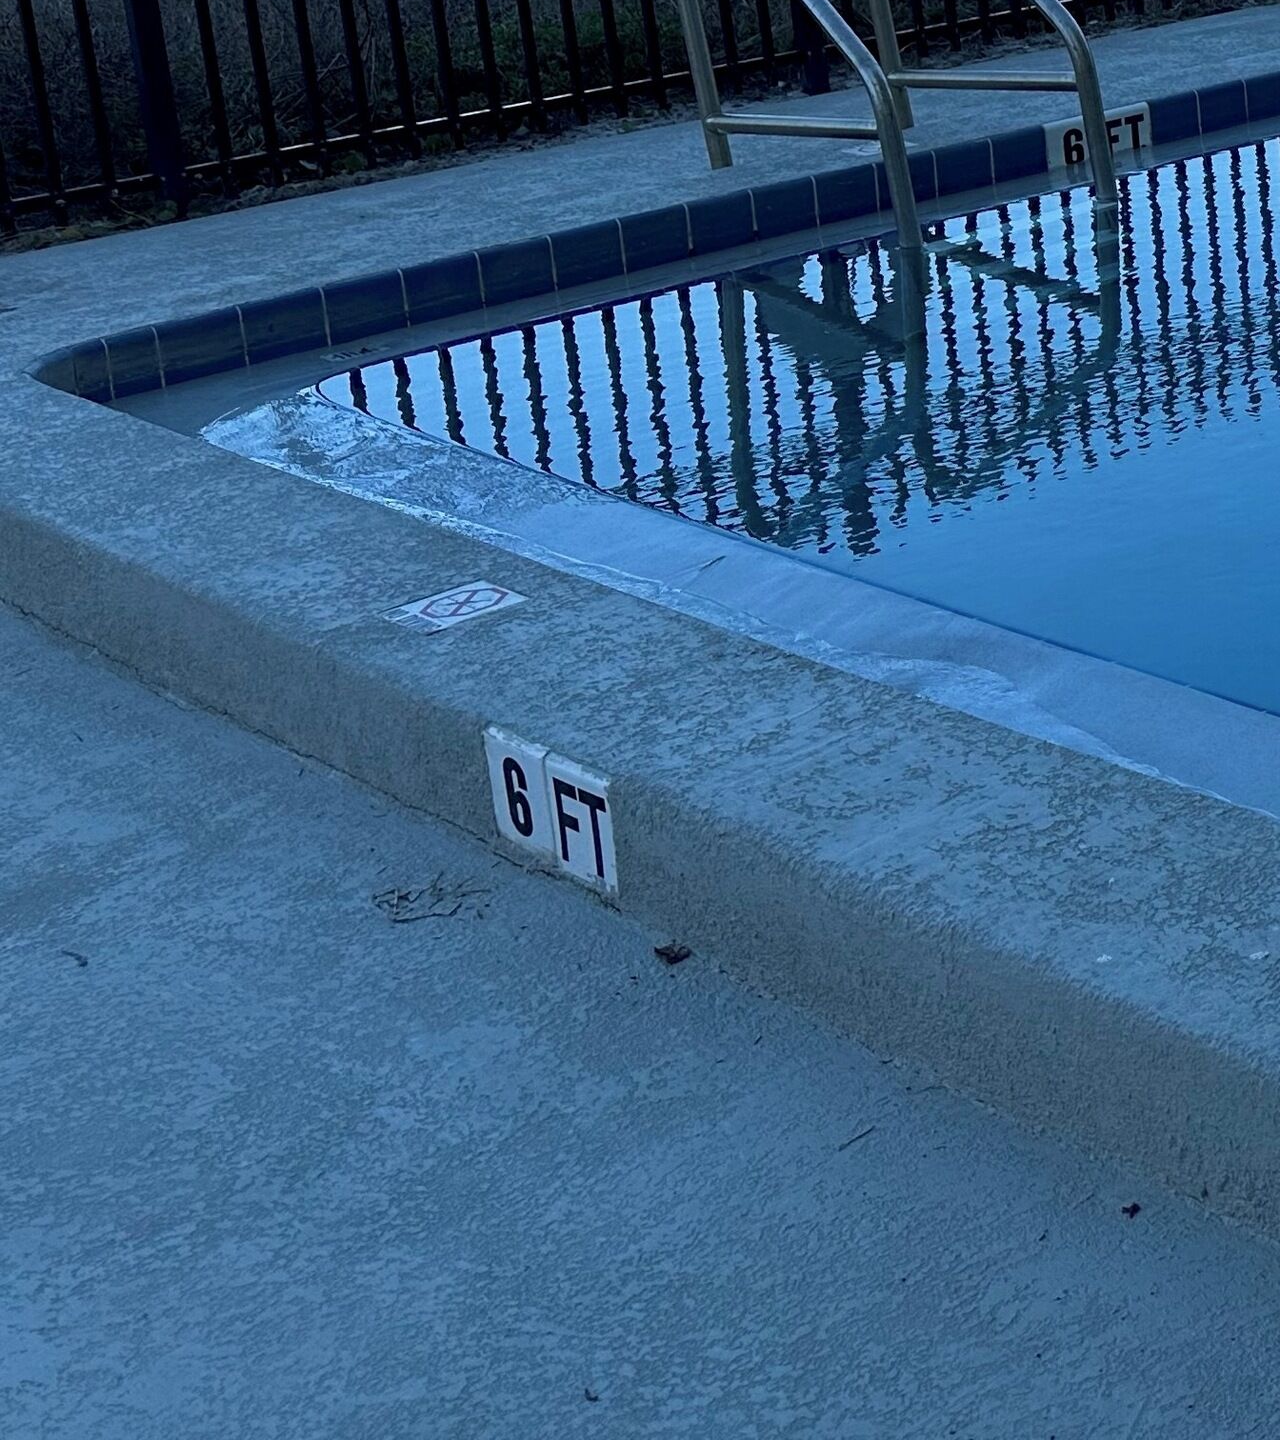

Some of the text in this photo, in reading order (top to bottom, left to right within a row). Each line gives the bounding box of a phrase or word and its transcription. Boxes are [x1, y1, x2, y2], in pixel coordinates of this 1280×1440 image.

[1063, 113, 1145, 165] 6 FT
[502, 756, 607, 880] 6 FT
